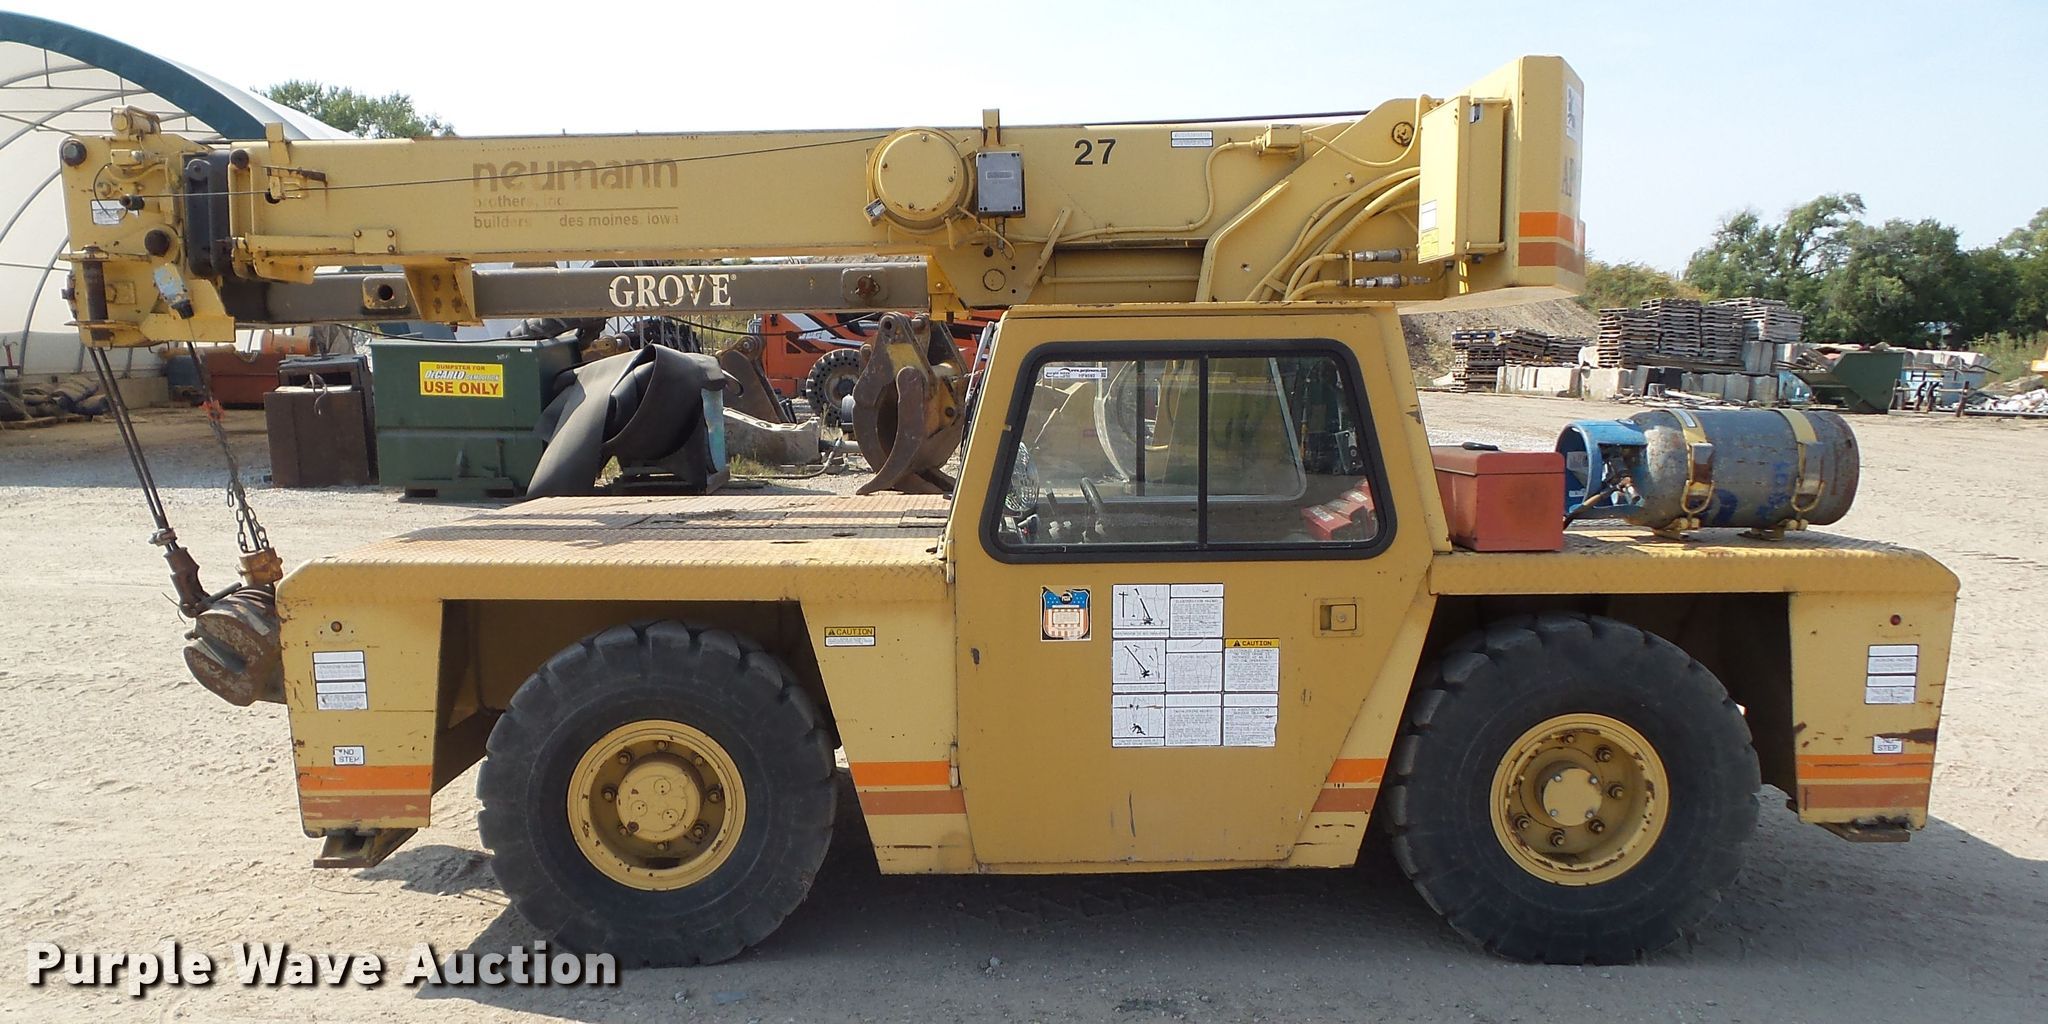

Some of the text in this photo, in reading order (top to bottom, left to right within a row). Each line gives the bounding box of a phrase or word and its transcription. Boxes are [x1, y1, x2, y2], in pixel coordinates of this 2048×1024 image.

[1074, 139, 1116, 165] 27
[473, 157, 679, 192] neumann
[559, 214, 584, 228] des
[609, 273, 731, 308] GROVE
[424, 381, 499, 395] USE ONLY
[836, 628, 873, 636] CAUTION
[343, 748, 355, 756] NO
